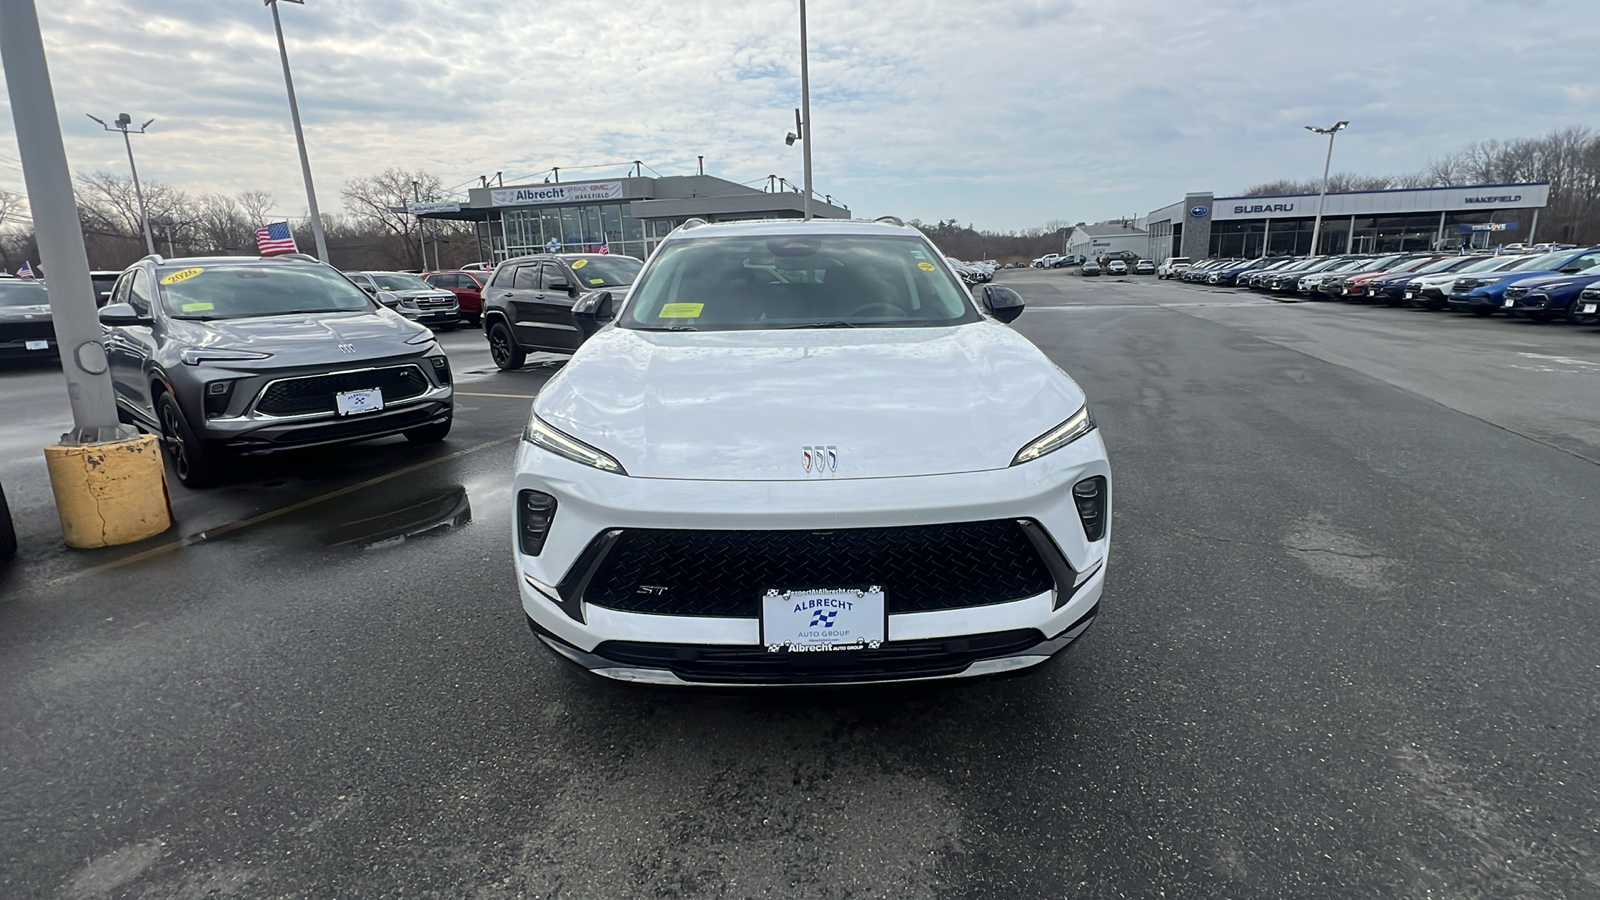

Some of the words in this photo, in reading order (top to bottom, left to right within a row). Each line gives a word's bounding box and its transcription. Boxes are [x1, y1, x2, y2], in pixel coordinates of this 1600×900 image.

[516, 188, 565, 200] Albrecht
[574, 192, 610, 200] WAKEFIELD
[1465, 195, 1522, 204] WAKEFIELD
[1234, 204, 1294, 214] SUBARU
[168, 269, 197, 282] 2026
[636, 585, 668, 596] ST
[794, 598, 853, 613] ALBRECHT
[788, 642, 833, 653] Albrecht
